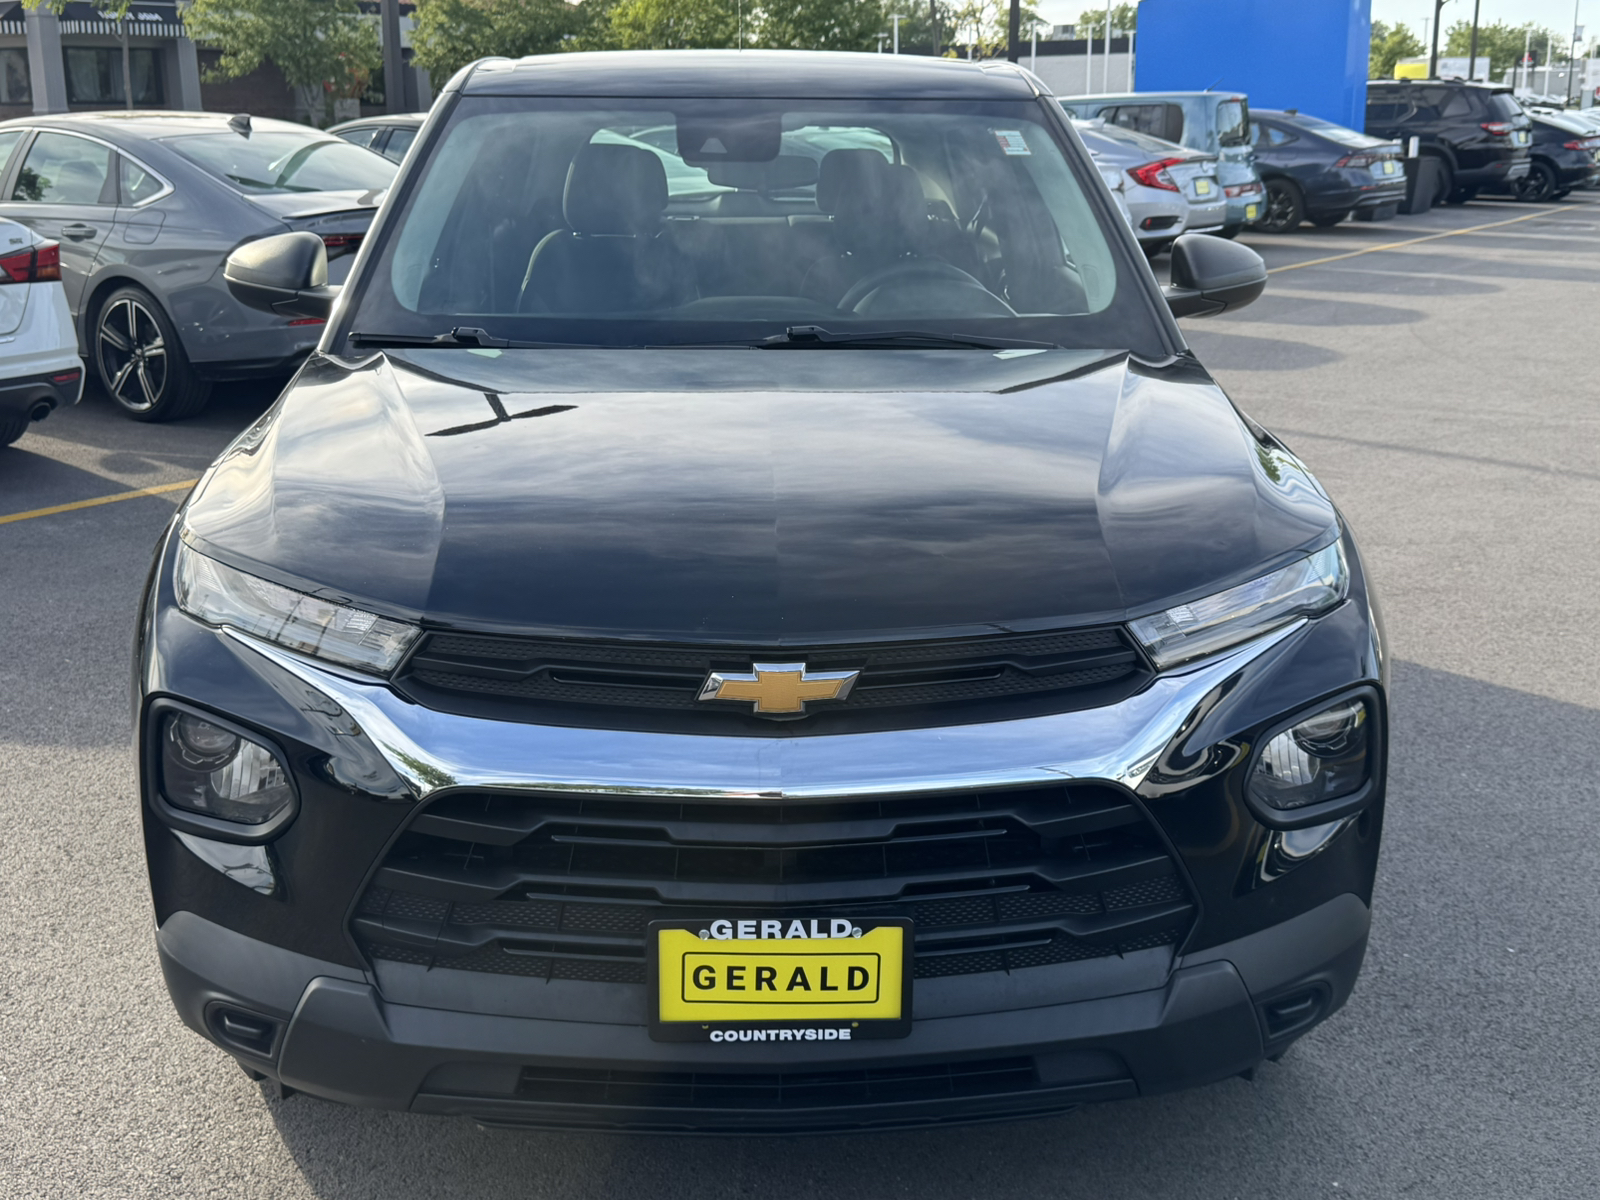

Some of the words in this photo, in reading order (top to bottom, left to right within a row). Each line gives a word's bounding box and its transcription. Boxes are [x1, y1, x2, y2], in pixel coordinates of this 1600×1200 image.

[709, 918, 853, 940] GERALD
[692, 964, 870, 991] GERALD
[709, 1028, 852, 1042] COUNTRYSIDE
